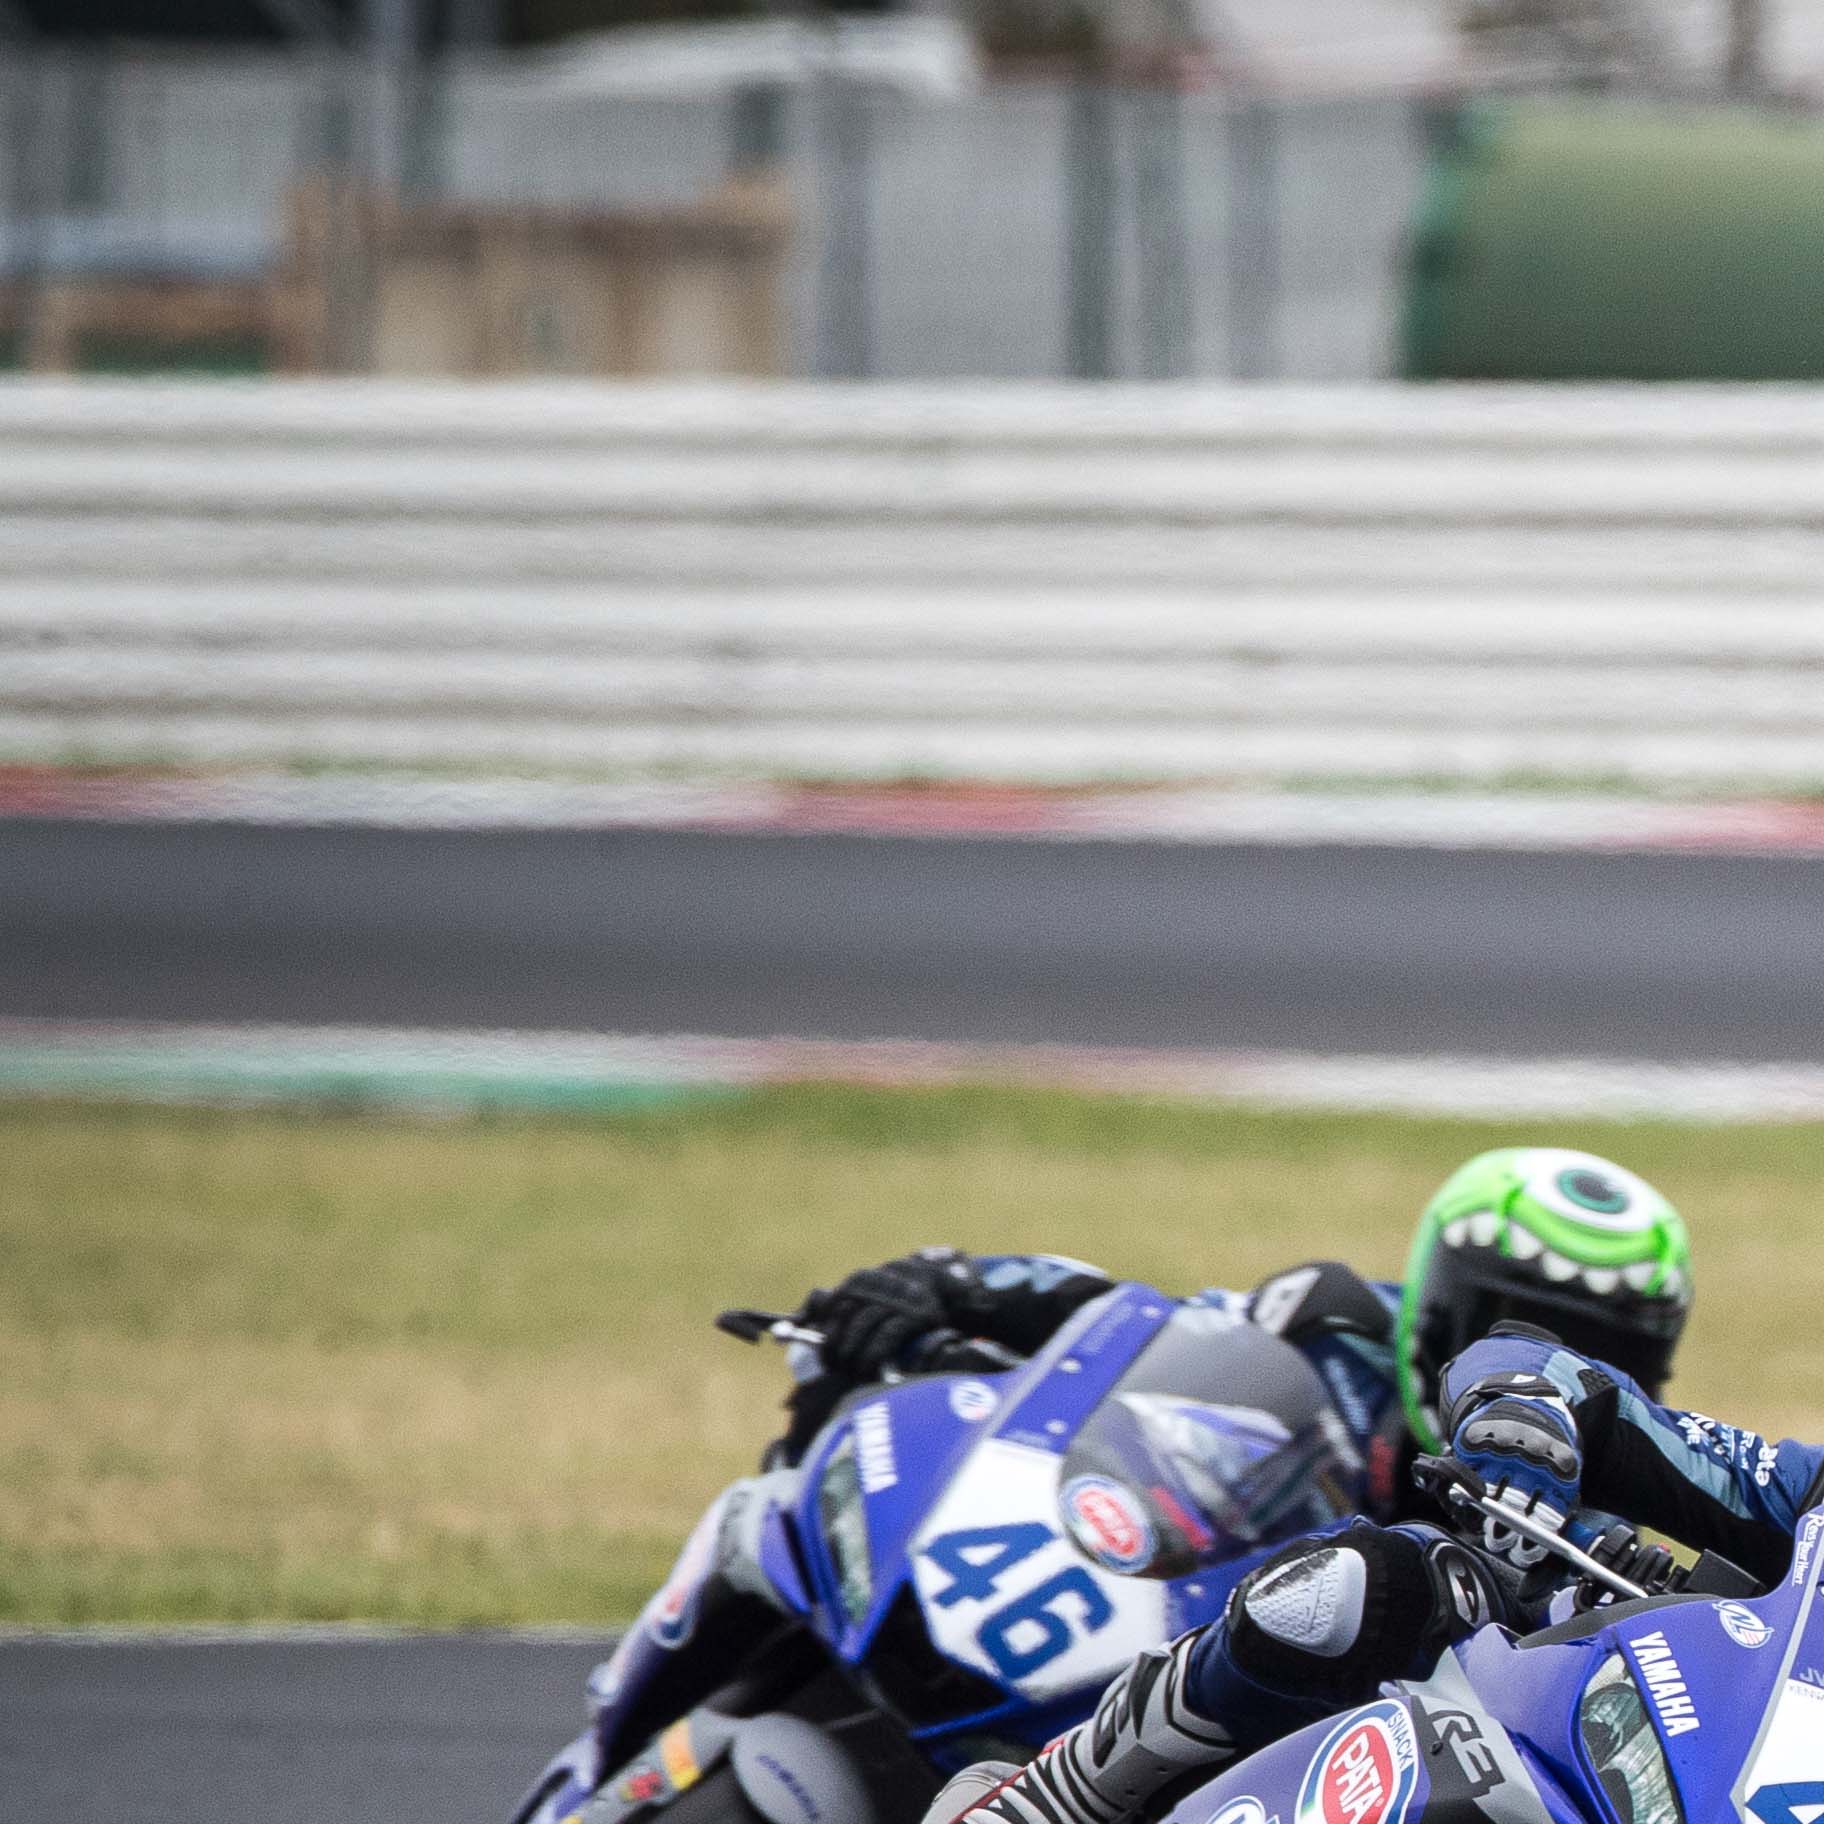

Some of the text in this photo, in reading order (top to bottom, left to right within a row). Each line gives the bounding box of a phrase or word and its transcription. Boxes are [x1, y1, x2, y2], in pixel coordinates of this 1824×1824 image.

[924, 1522, 1113, 1678] 46
[1629, 1630, 1701, 1738] YAMAHA
[1384, 1710, 1415, 1768] SNACK
